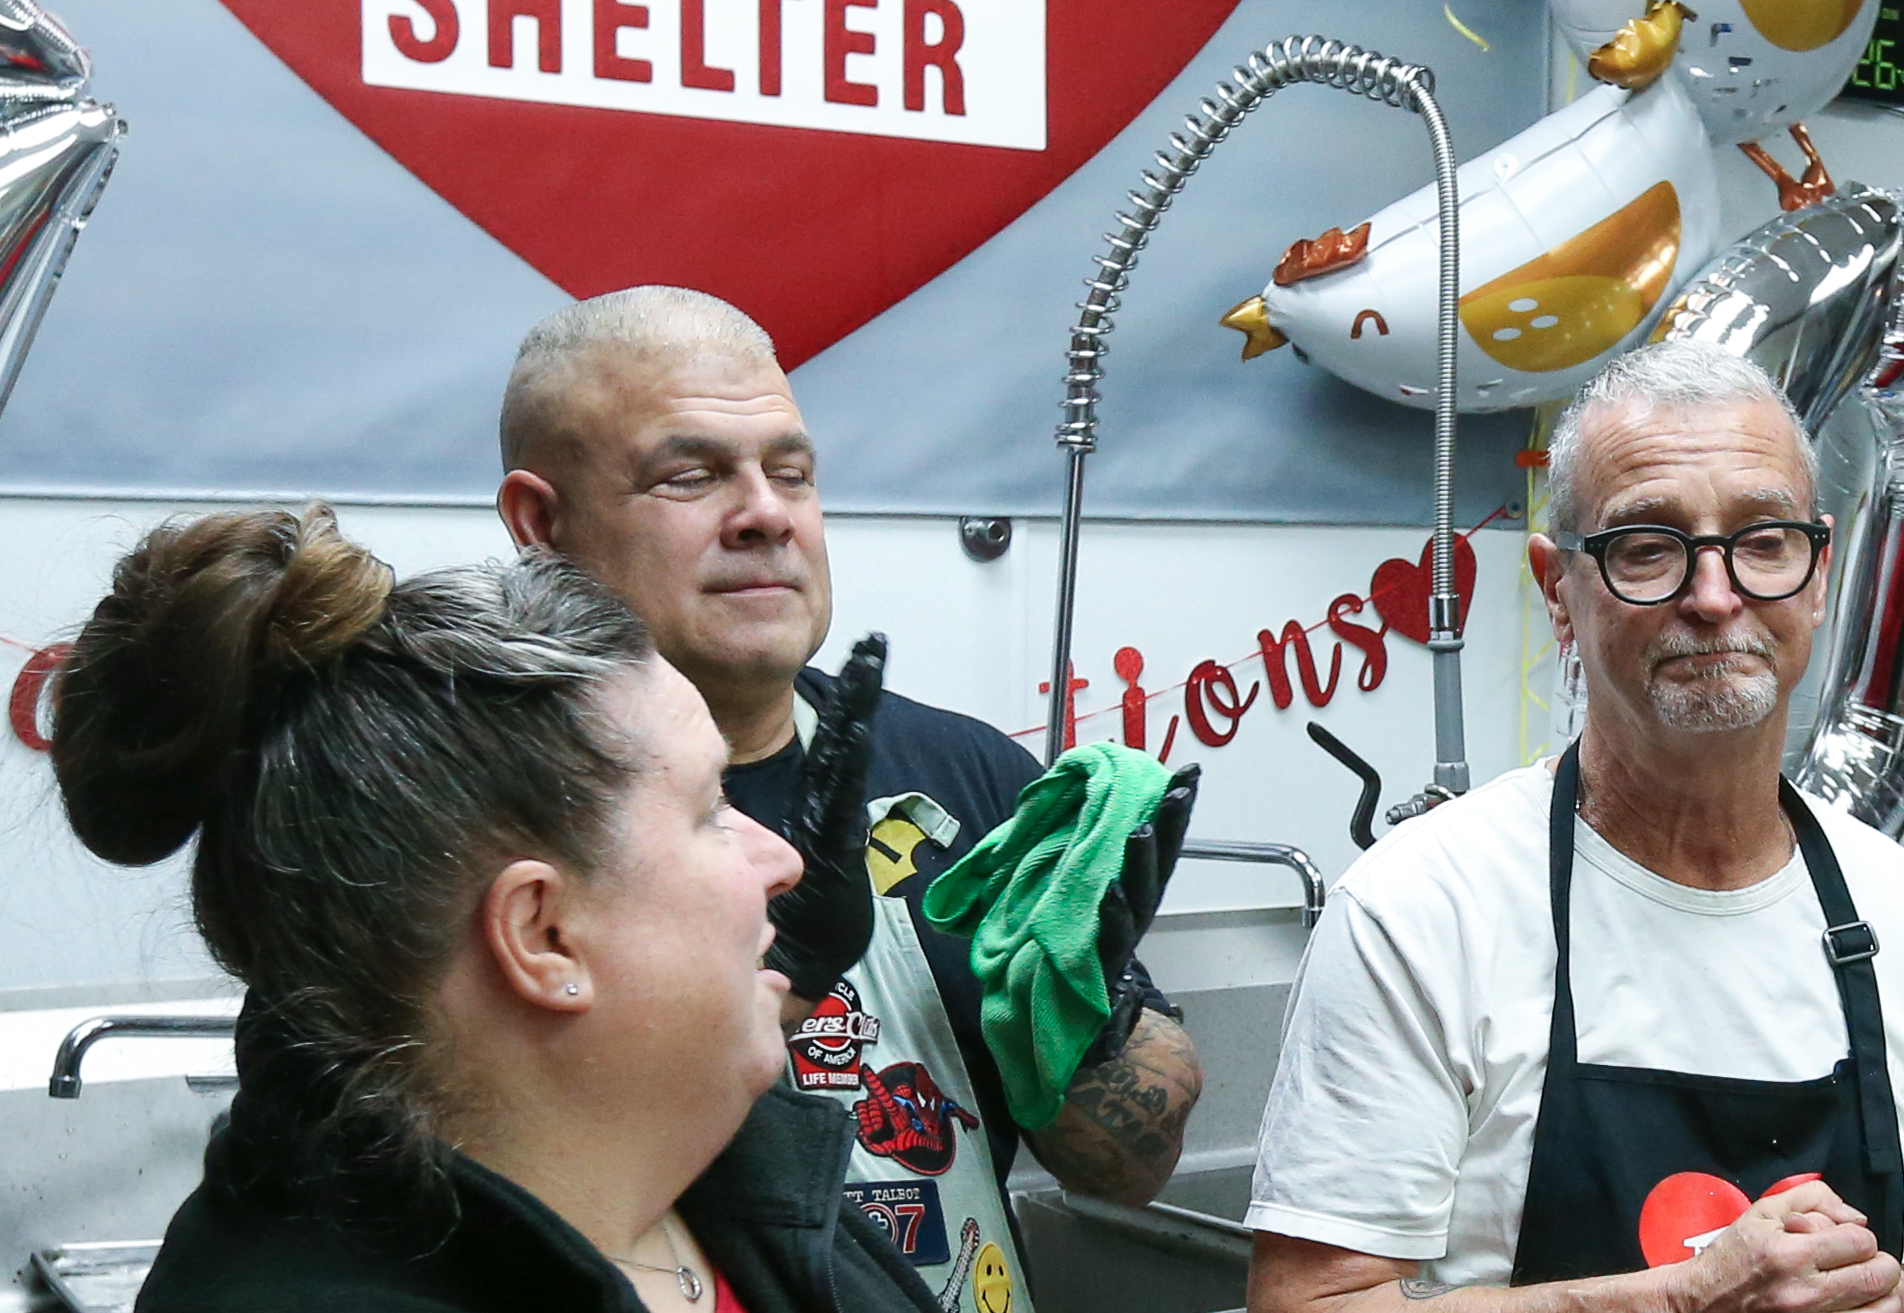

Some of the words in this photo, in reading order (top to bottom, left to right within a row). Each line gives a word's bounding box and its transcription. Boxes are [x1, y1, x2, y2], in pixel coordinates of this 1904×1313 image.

[387, 0, 967, 117] SHELTER
[807, 1045, 824, 1060] OF
[801, 1072, 827, 1086] LIFE
[871, 1187, 921, 1202] TALBOT
